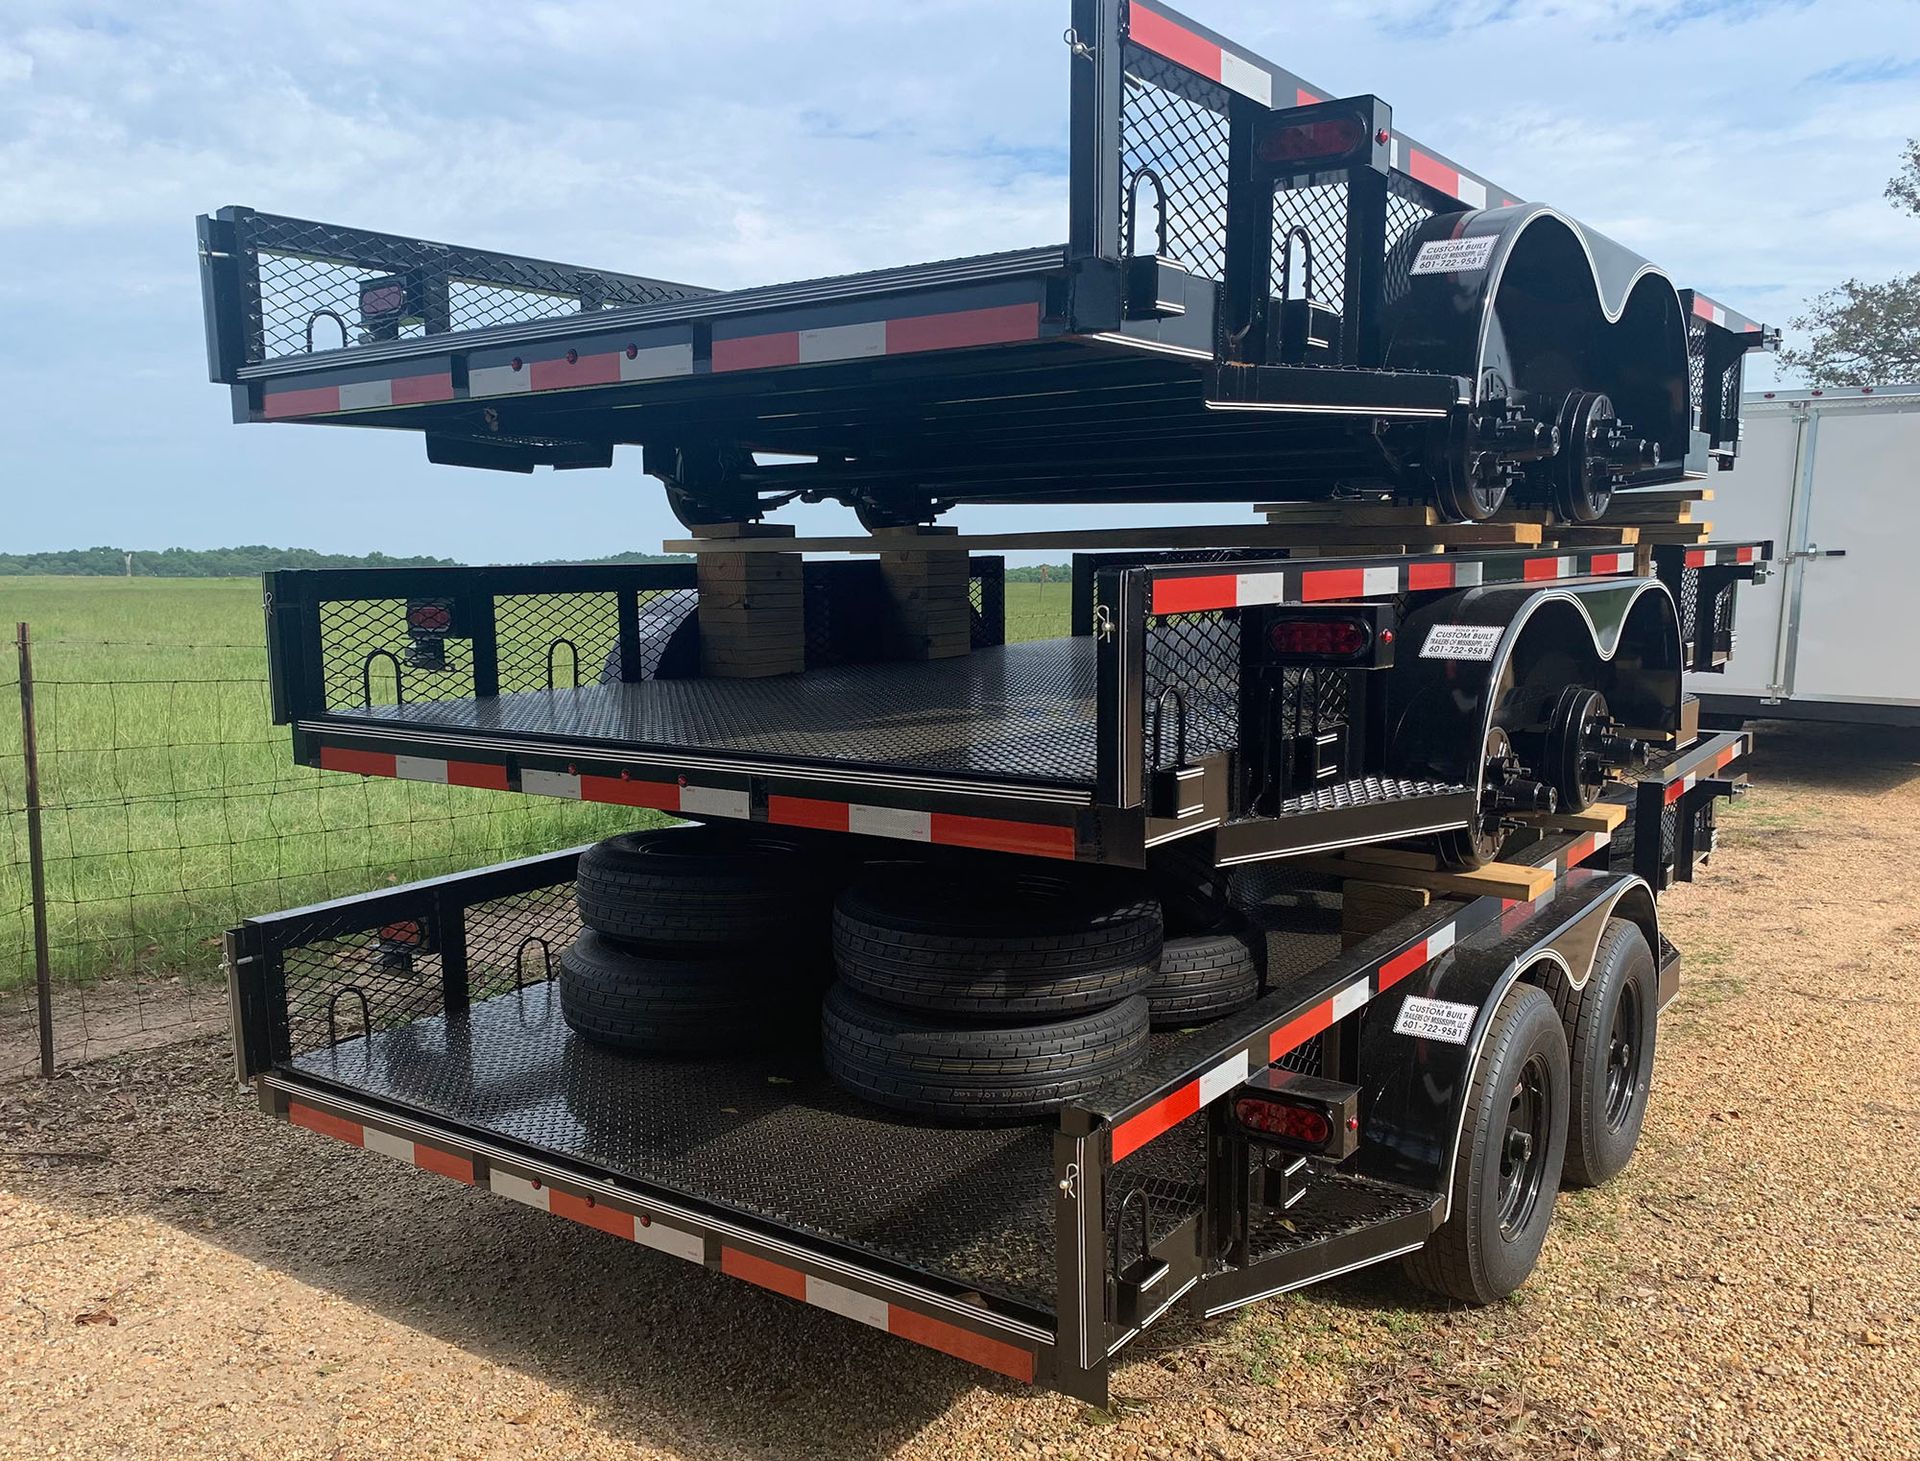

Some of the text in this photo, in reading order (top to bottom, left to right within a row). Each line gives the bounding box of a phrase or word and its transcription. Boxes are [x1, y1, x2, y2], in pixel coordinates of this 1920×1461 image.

[1420, 257, 1482, 269] 601-722-9581
[1429, 645, 1488, 654] 601-722-9581
[1403, 1011, 1423, 1020] TRAILERS
[1409, 1005, 1467, 1019] CUSTOM BUILT
[1402, 1019, 1462, 1037] 601-722-9581
